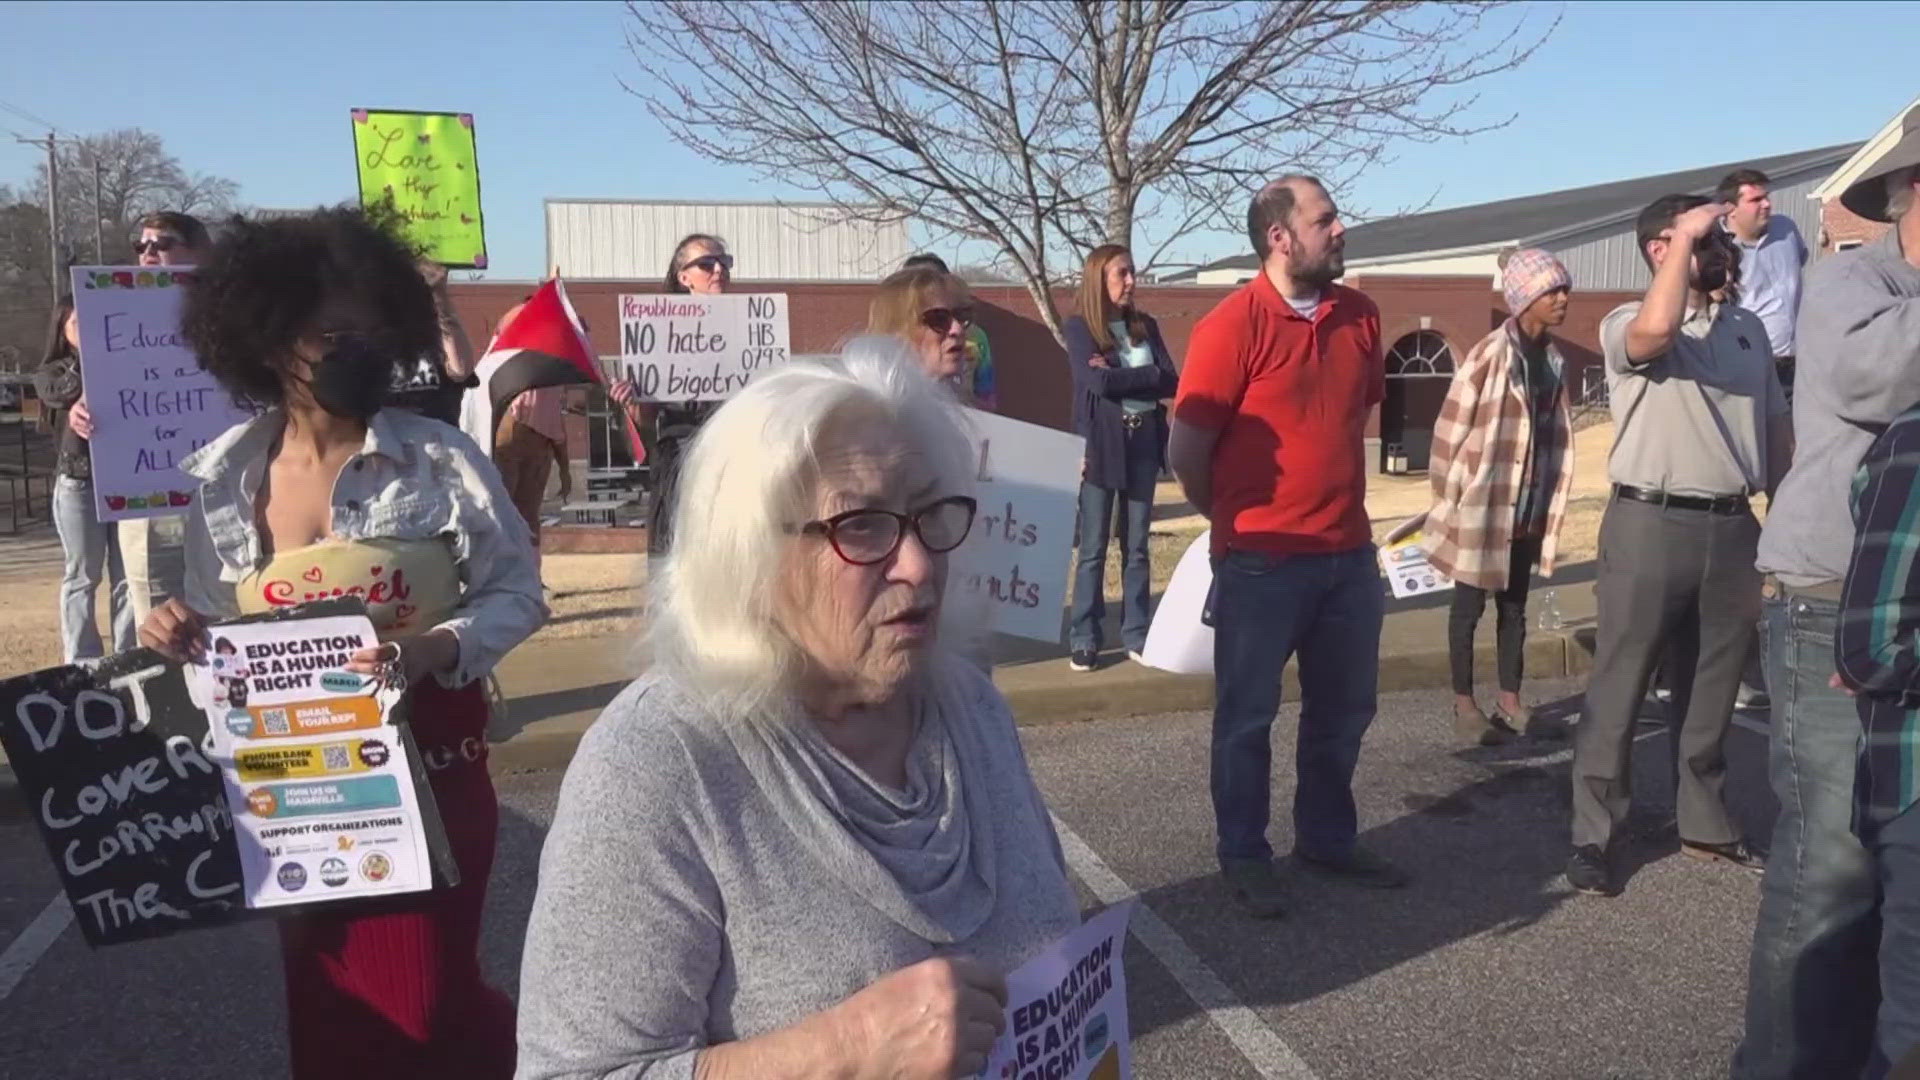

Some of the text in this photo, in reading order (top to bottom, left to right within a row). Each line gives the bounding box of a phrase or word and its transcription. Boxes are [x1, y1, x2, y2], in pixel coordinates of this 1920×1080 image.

[623, 297, 712, 318] Republicans:
[747, 296, 776, 320] NO
[104, 312, 183, 352] Educa
[624, 321, 727, 356] NO hate
[748, 323, 776, 347] HB
[144, 366, 160, 381] is
[627, 362, 750, 401] NO bigotry
[118, 388, 214, 420] RIGHT
[155, 427, 183, 442] for
[134, 448, 175, 474] ALL
[982, 501, 1038, 547] rts
[245, 635, 363, 660] EDUCATION
[250, 652, 355, 677] IS A HUMA
[253, 673, 313, 693] RIGHT
[244, 758, 310, 771] VOLUNTEER
[260, 817, 403, 839] SUPPORT ORGANIZATIONS
[185, 849, 241, 898] C
[1012, 936, 1113, 1037] EDUCATION
[1016, 1034, 1040, 1069] IS
[1044, 1024, 1061, 1055] A
[1061, 965, 1112, 1041] HUMAN
